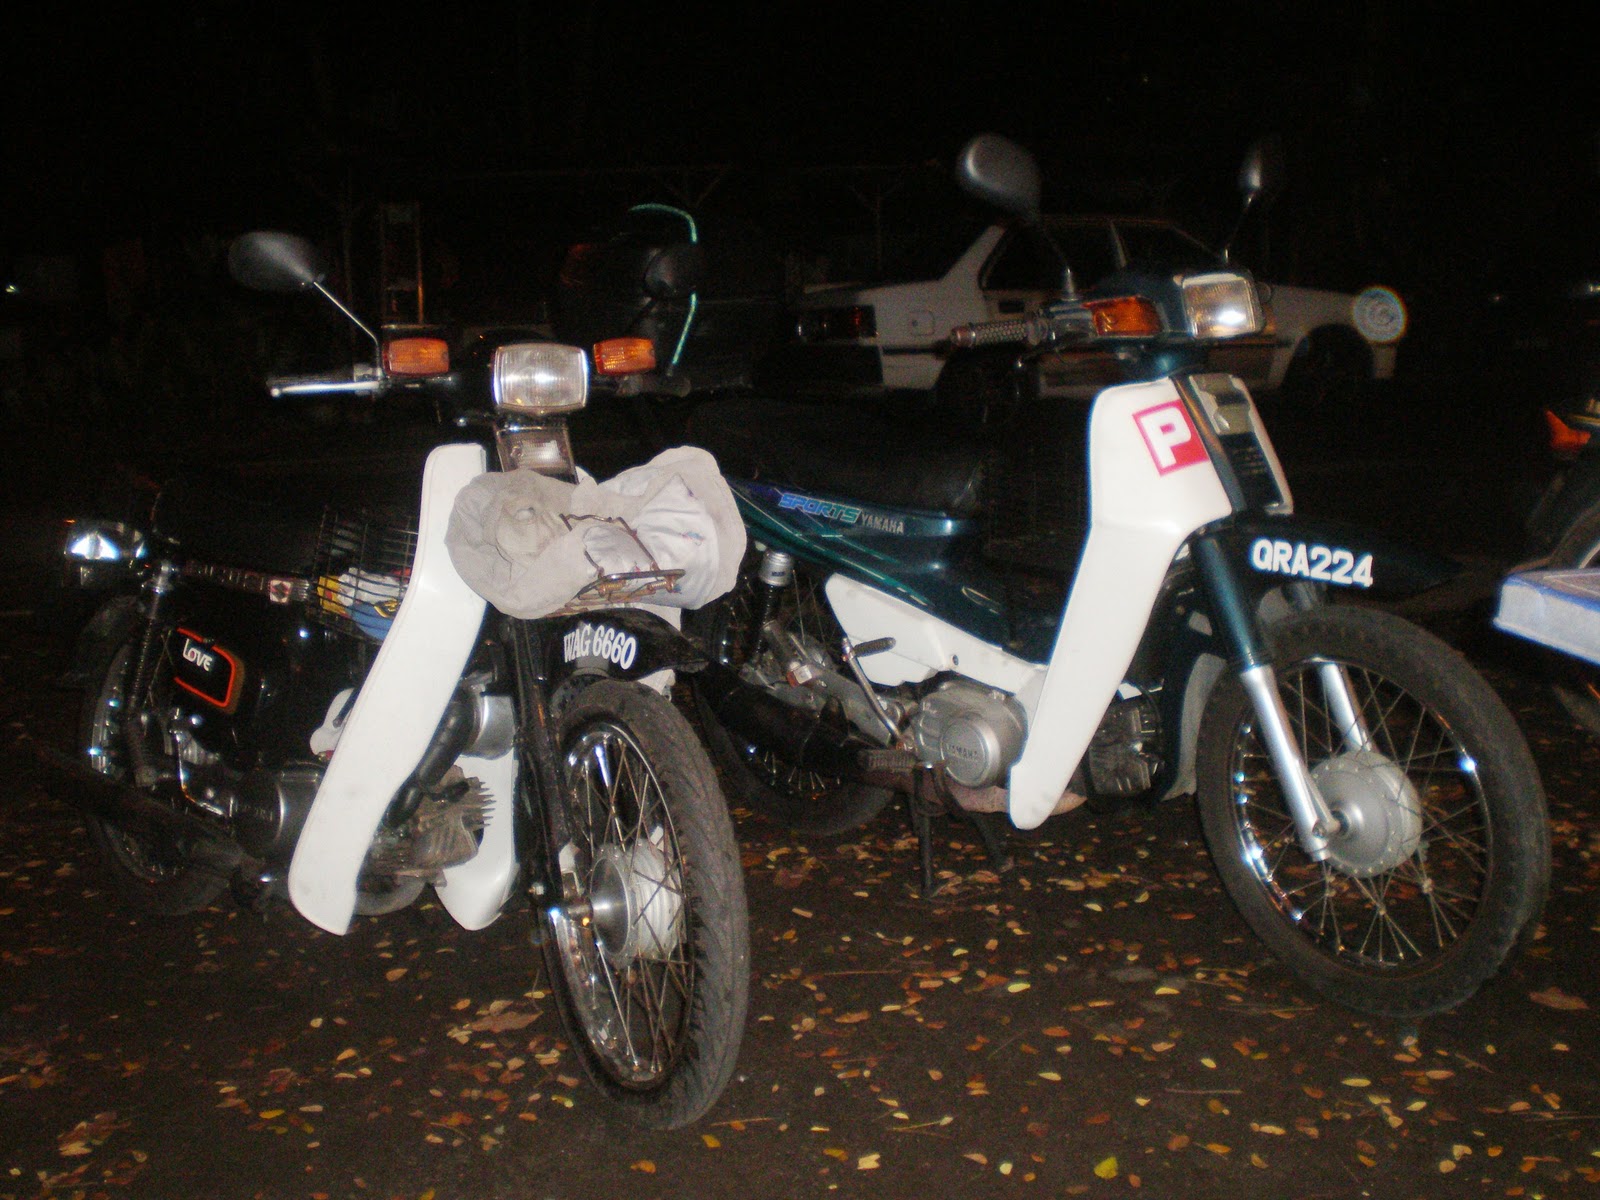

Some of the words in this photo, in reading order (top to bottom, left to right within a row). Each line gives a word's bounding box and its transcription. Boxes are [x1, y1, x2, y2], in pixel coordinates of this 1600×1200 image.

[1140, 406, 1192, 468] P
[778, 492, 862, 523] SPORTS
[861, 512, 904, 534] YAMAHA
[1252, 538, 1373, 587] QRA224
[563, 623, 592, 663] WAG
[592, 624, 637, 670] 6660
